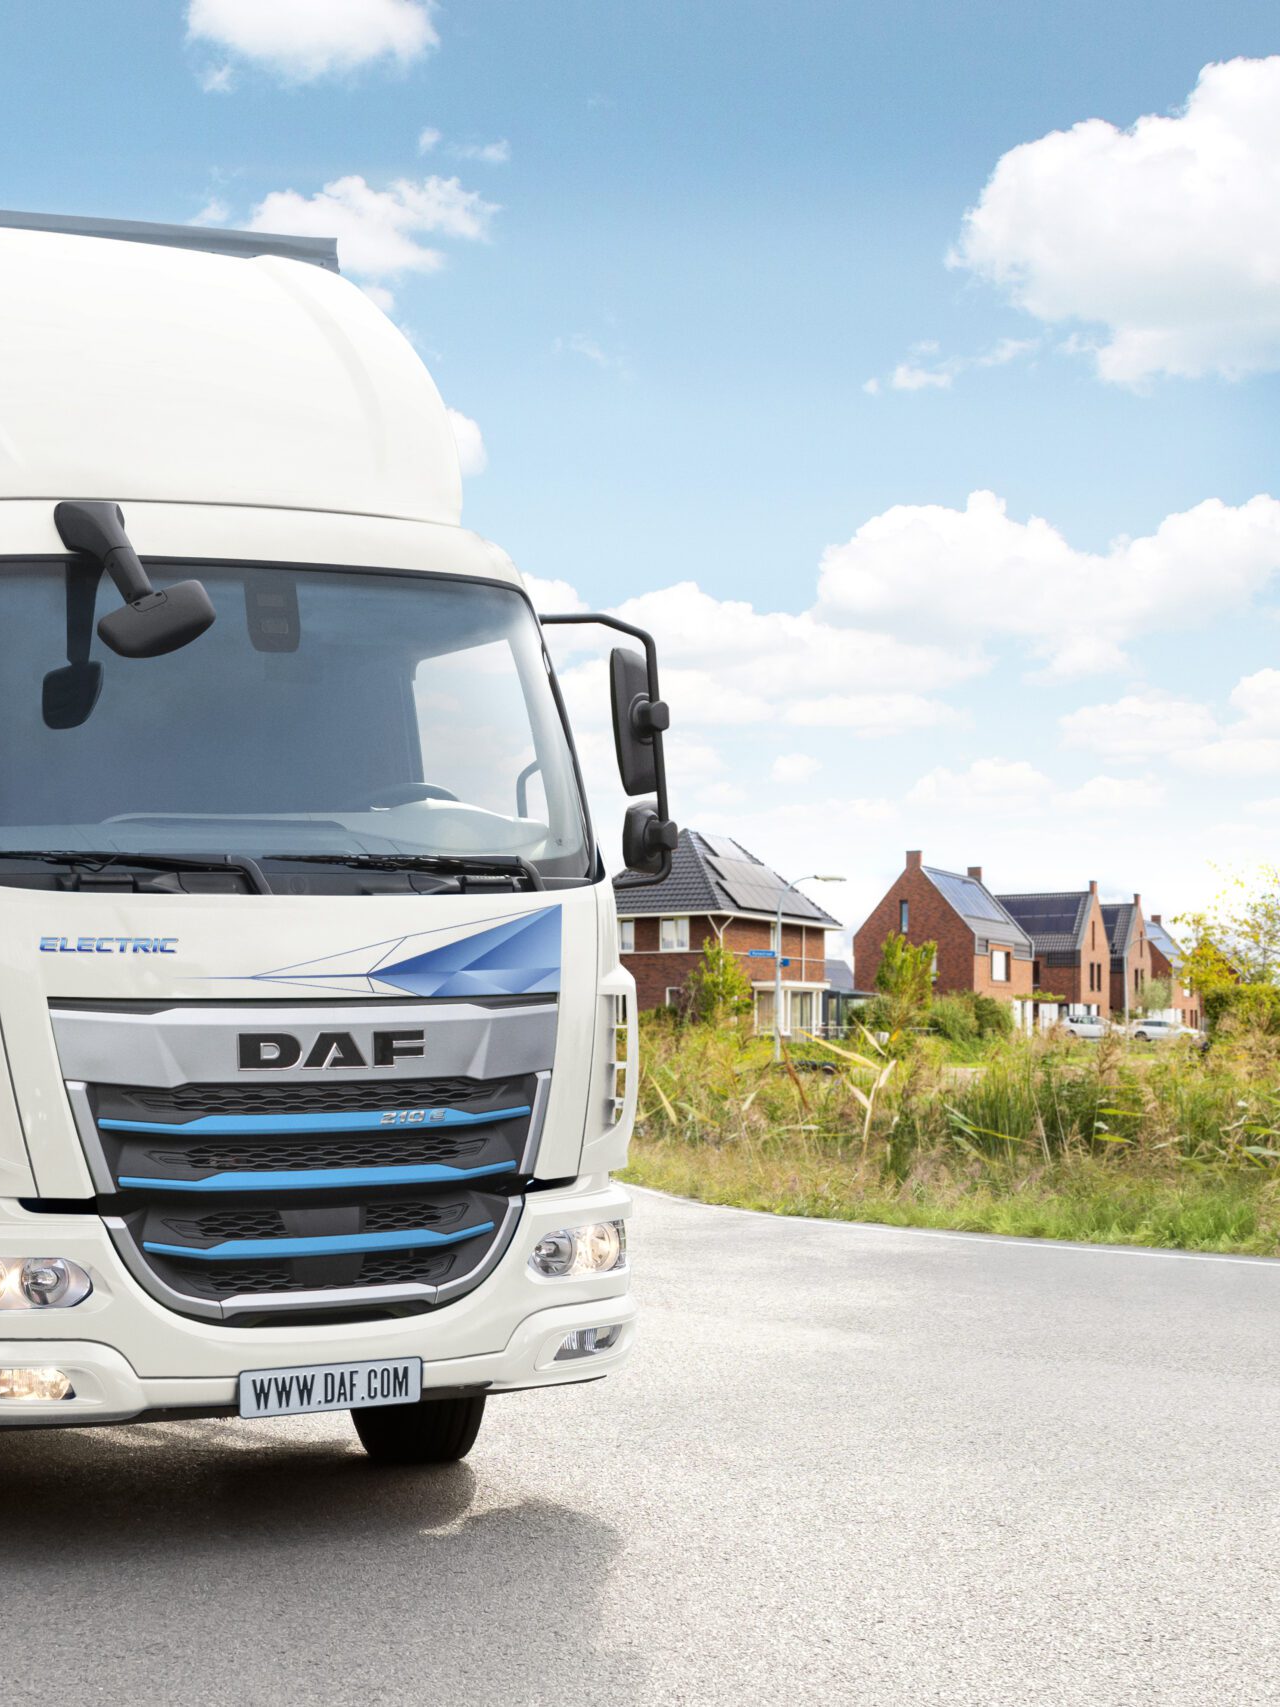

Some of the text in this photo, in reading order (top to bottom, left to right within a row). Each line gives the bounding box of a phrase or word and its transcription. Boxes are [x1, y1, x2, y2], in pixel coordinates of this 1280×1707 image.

[39, 936, 179, 953] ELECTRIC
[237, 1029, 425, 1071] DAF
[380, 1108, 446, 1124] 210 E
[252, 1366, 409, 1410] WWW.DAF.COM
